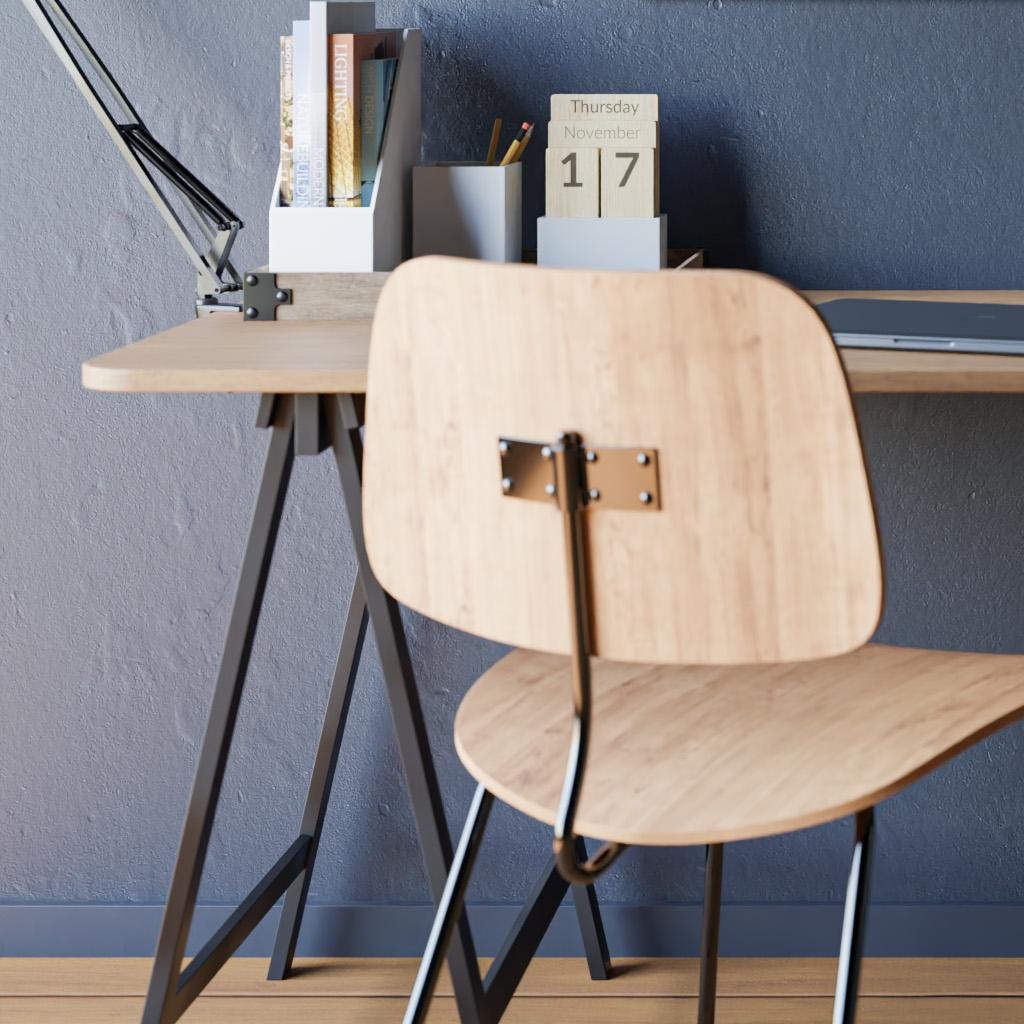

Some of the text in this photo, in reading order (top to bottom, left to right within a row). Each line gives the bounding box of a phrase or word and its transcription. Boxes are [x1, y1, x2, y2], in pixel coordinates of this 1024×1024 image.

[334, 44, 348, 122] LIGHTING
[570, 99, 640, 116] Thursday
[564, 125, 641, 140] November
[561, 152, 640, 187] 1 7
